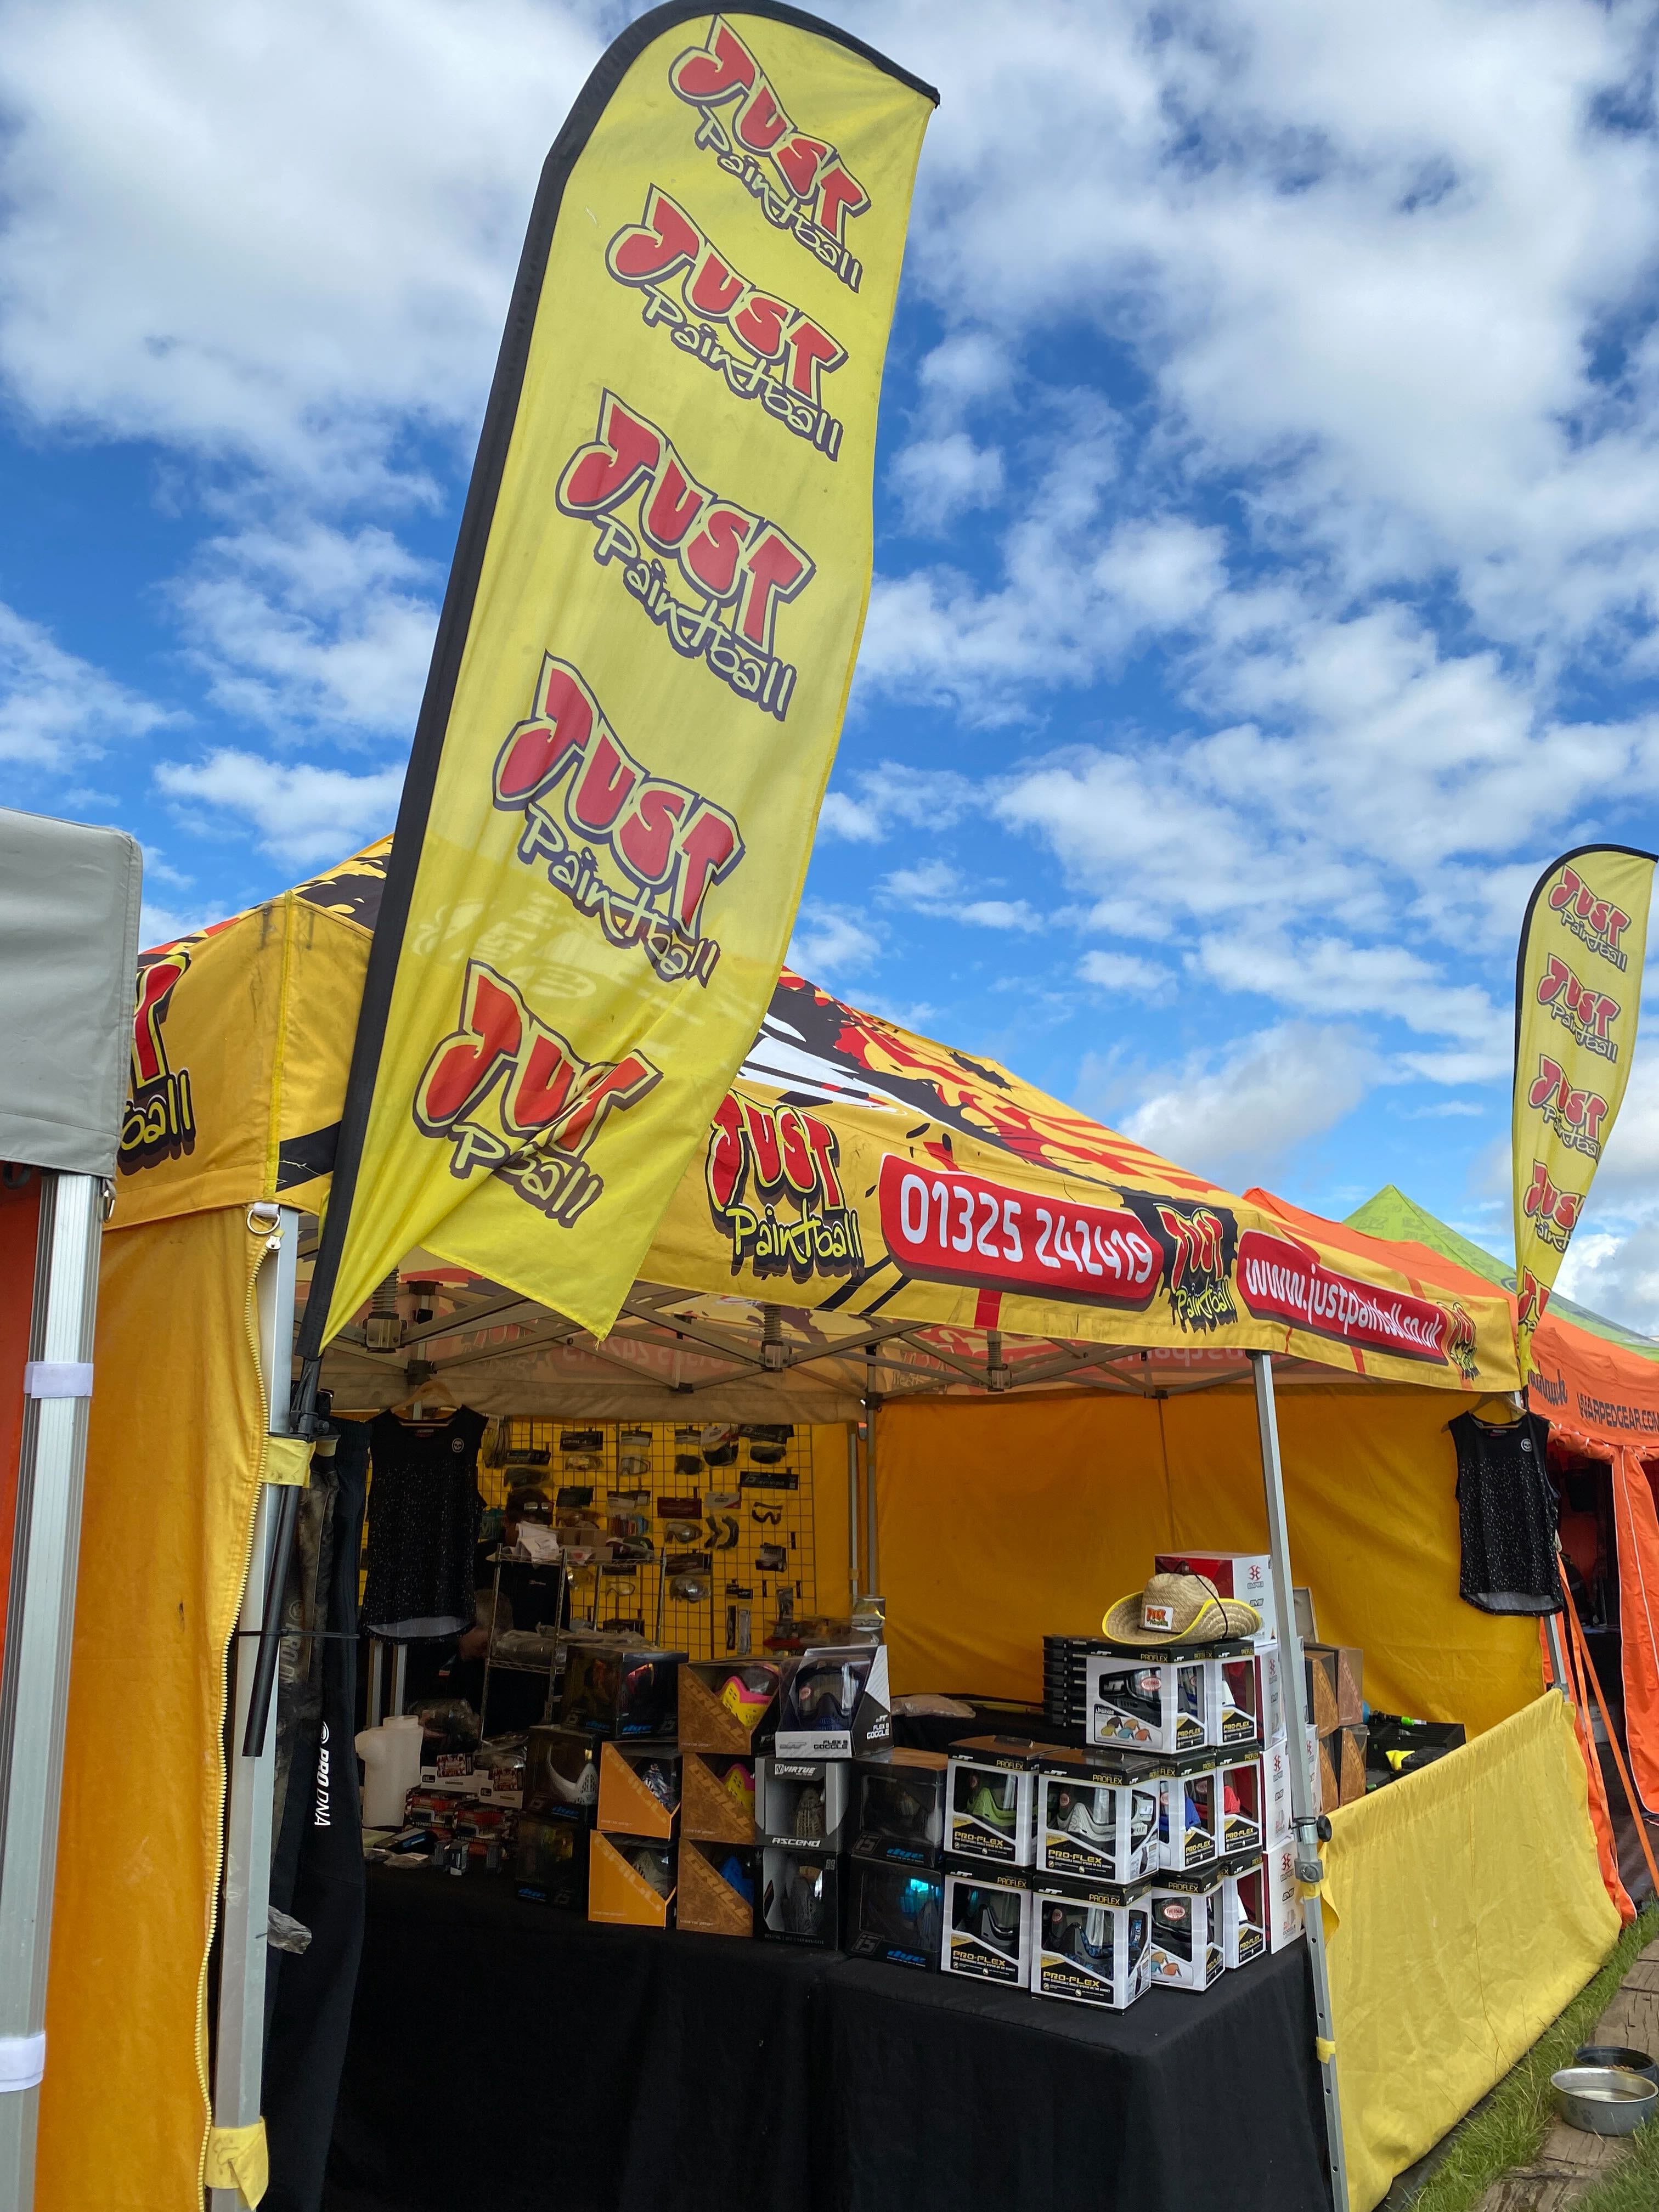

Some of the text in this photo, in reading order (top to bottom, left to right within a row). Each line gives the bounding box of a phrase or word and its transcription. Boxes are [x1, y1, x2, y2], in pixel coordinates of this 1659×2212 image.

[668, 14, 871, 249] JUST
[695, 104, 864, 294] Paintball
[605, 184, 848, 409] JUST
[642, 284, 843, 462] Paintball
[555, 387, 816, 658] JUST
[592, 512, 797, 722] Paintball
[493, 648, 746, 941] JUST
[517, 802, 720, 989] Paintball
[1548, 864, 1632, 949] JUST
[1561, 908, 1627, 972] Paintball
[1537, 952, 1621, 1040] JUST
[412, 958, 663, 1158] JUT
[1550, 1001, 1618, 1063] Paintball
[1528, 1053, 1609, 1142] JUST
[705, 1088, 846, 1212] JUST
[725, 1198, 865, 1266] Paintball
[900, 1173, 1153, 1285] 01325 242419
[1176, 1275, 1238, 1319] Paintball
[1141, 1654, 1168, 1662] PROFLEX
[866, 1729, 890, 1740] GOGGLE
[996, 1759, 1024, 1770] PROFLEX
[314, 1747, 331, 1826] PRO DNA
[784, 1765, 817, 1774] VIRTUE
[1093, 1774, 1122, 1785] PROFLEX
[1160, 1768, 1176, 1776] FLEX
[955, 1831, 1003, 1847] PRO-FLEX
[1048, 1849, 1102, 1864] PRO-FLEX
[997, 1876, 1026, 1888] PROFLEX
[1089, 1894, 1120, 1905] PROFLEX
[1168, 1882, 1199, 1893] PROFLEX
[953, 1950, 1006, 1967] PRO-FLEX
[1043, 1971, 1100, 1987] PRO-FLEX
